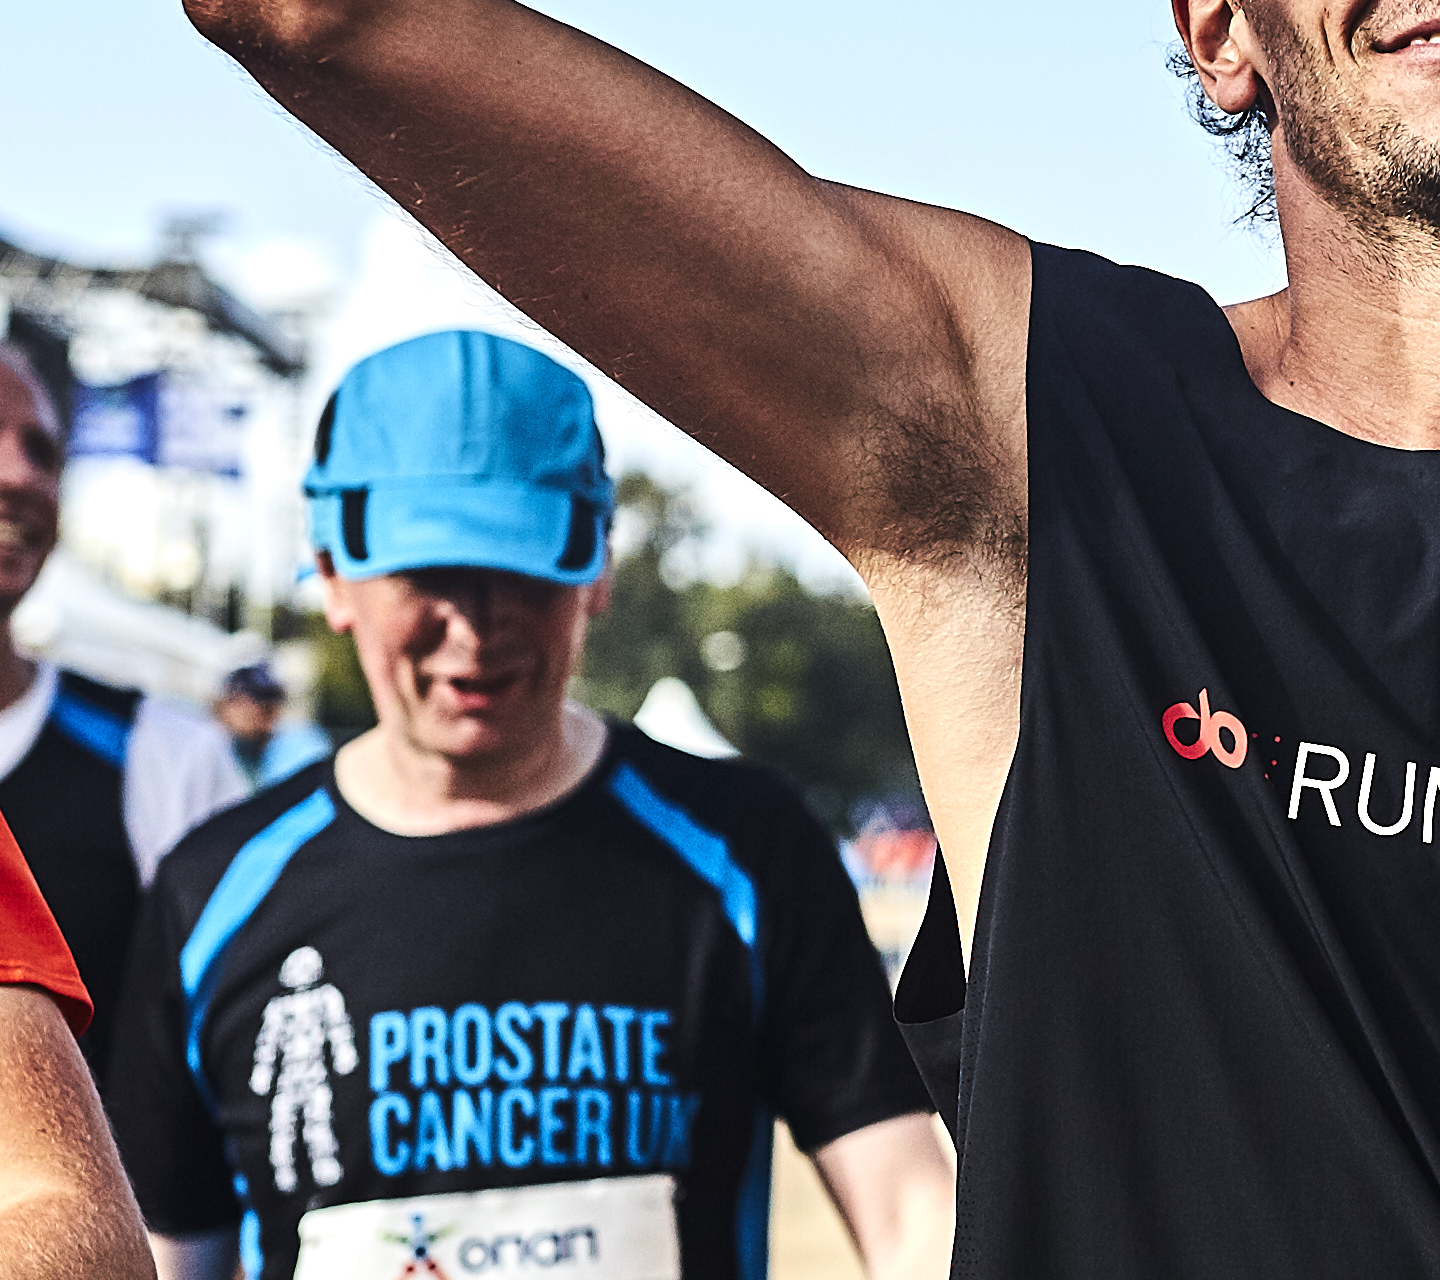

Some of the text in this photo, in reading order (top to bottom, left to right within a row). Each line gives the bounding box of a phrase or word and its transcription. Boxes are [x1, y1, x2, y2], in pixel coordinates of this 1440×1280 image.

[369, 1001, 675, 1091] PROSTATE
[369, 1090, 698, 1176] CANCER UK
